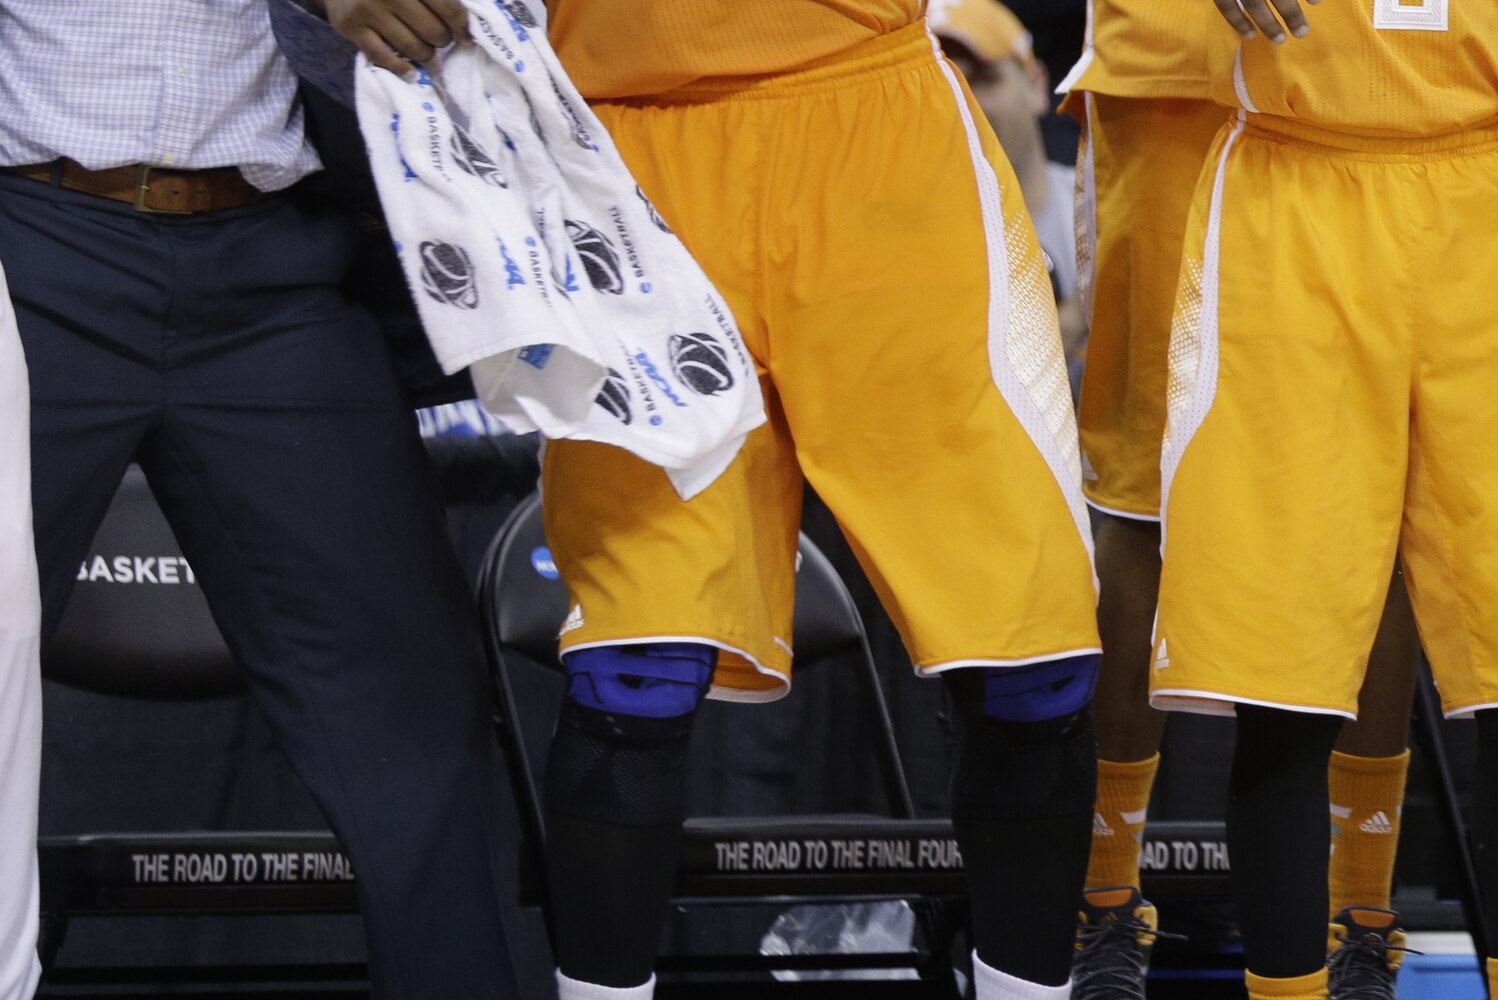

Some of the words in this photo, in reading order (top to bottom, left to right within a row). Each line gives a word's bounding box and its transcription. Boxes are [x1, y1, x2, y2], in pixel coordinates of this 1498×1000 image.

[608, 206, 645, 279] BASKETBALL
[131, 854, 169, 882] THE
[174, 853, 227, 882] ROAD
[231, 853, 257, 882] TO
[261, 853, 298, 880] THE
[302, 852, 355, 880] FINAL
[714, 841, 749, 870] THE
[752, 841, 800, 870] ROAD
[803, 840, 828, 869] TO
[831, 840, 864, 868] THE
[867, 840, 914, 868] FINAL
[917, 839, 964, 868] FOUR
[1171, 841, 1199, 870] TO
